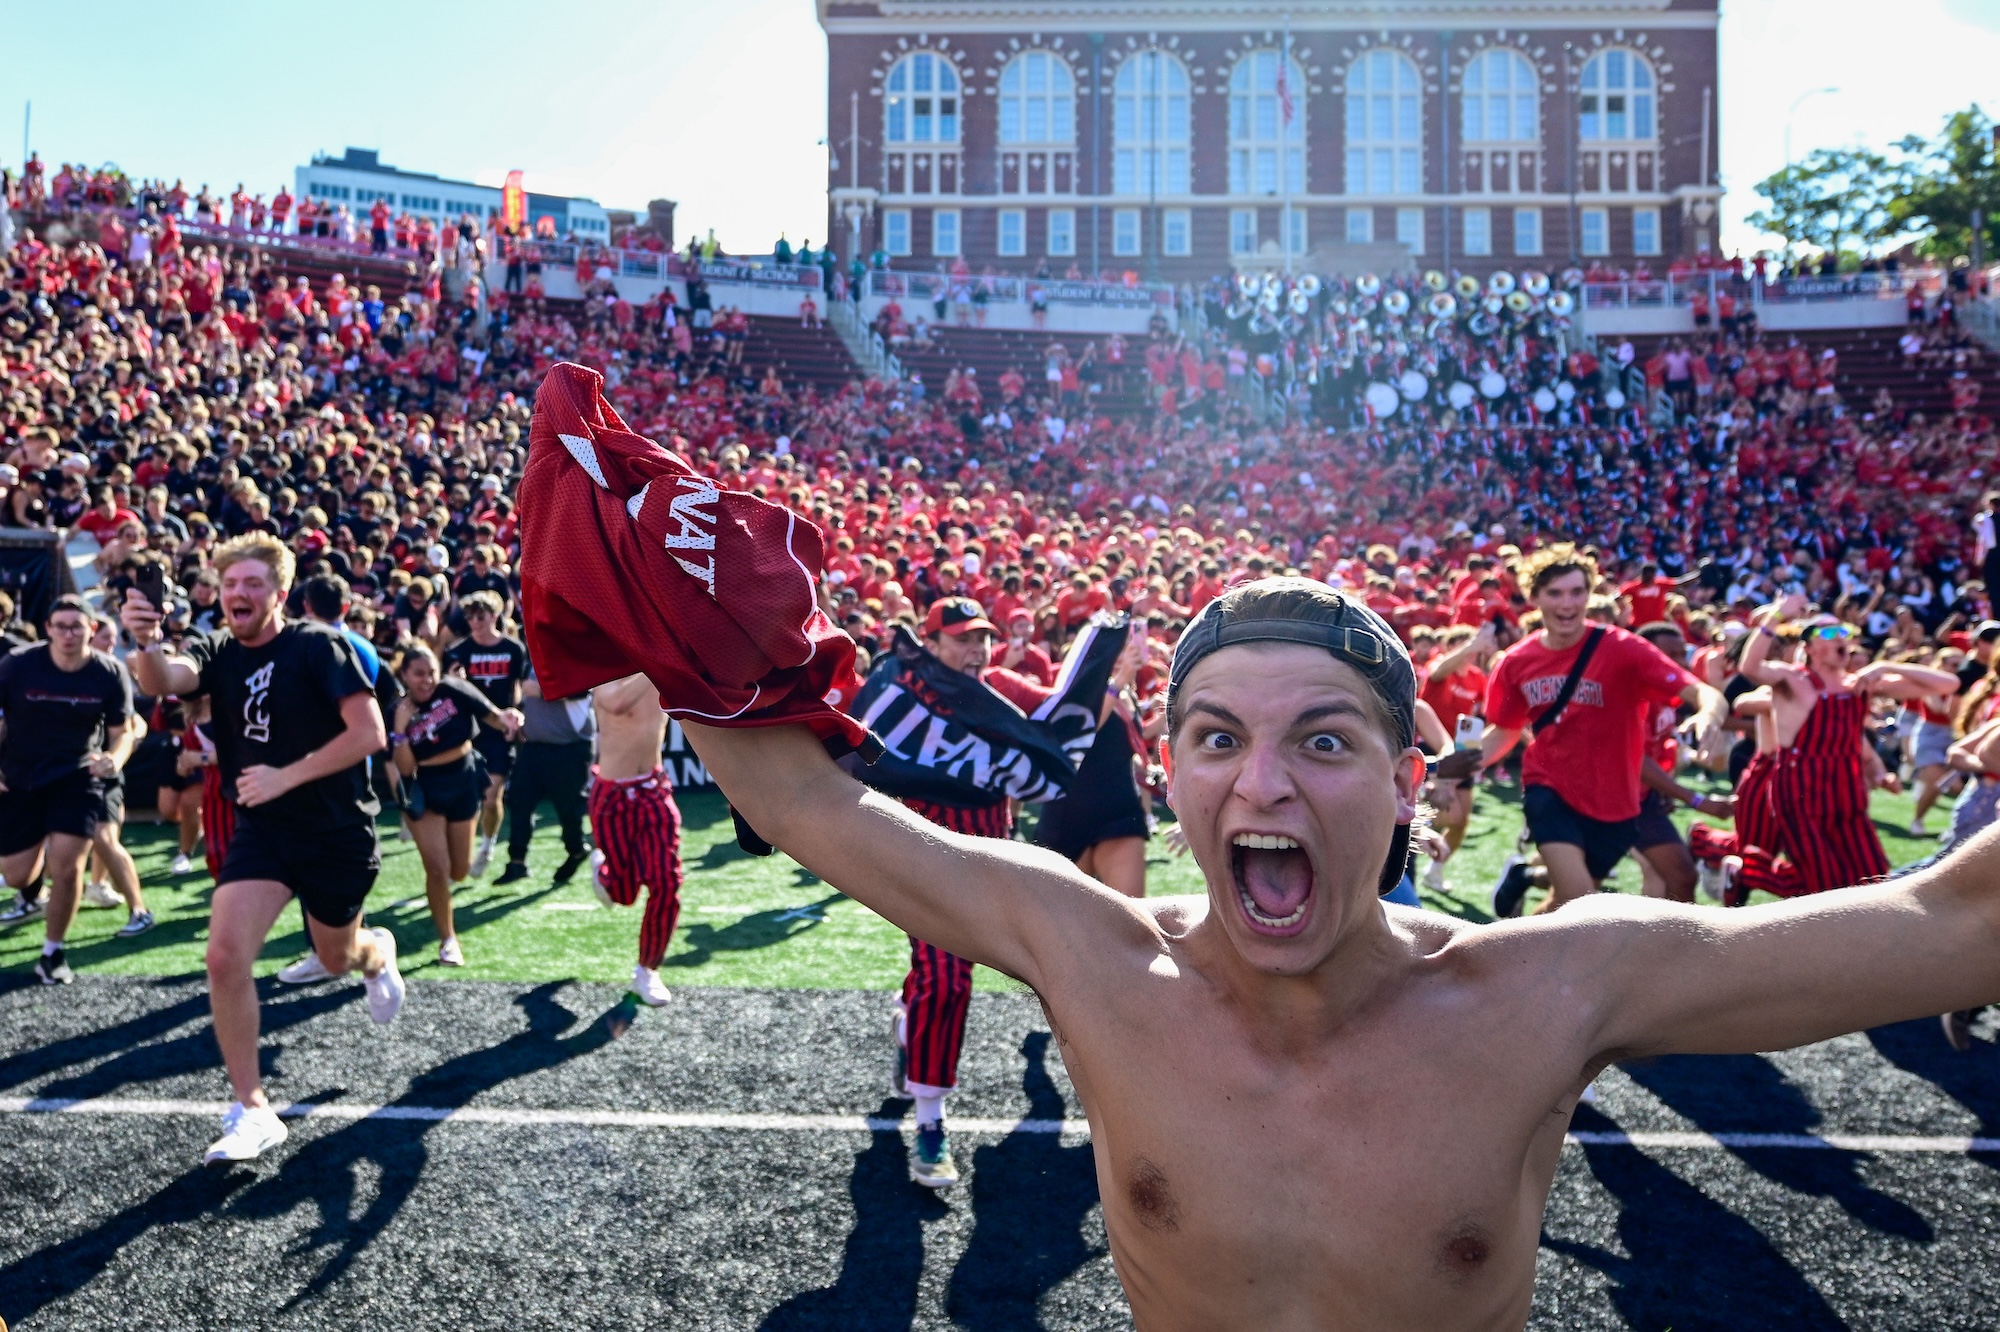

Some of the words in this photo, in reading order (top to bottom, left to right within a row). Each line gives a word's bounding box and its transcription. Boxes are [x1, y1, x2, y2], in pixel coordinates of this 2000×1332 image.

[751, 269, 799, 282] SECTION
[1047, 286, 1093, 299] STUDENT
[1105, 290, 1150, 301] SECTION
